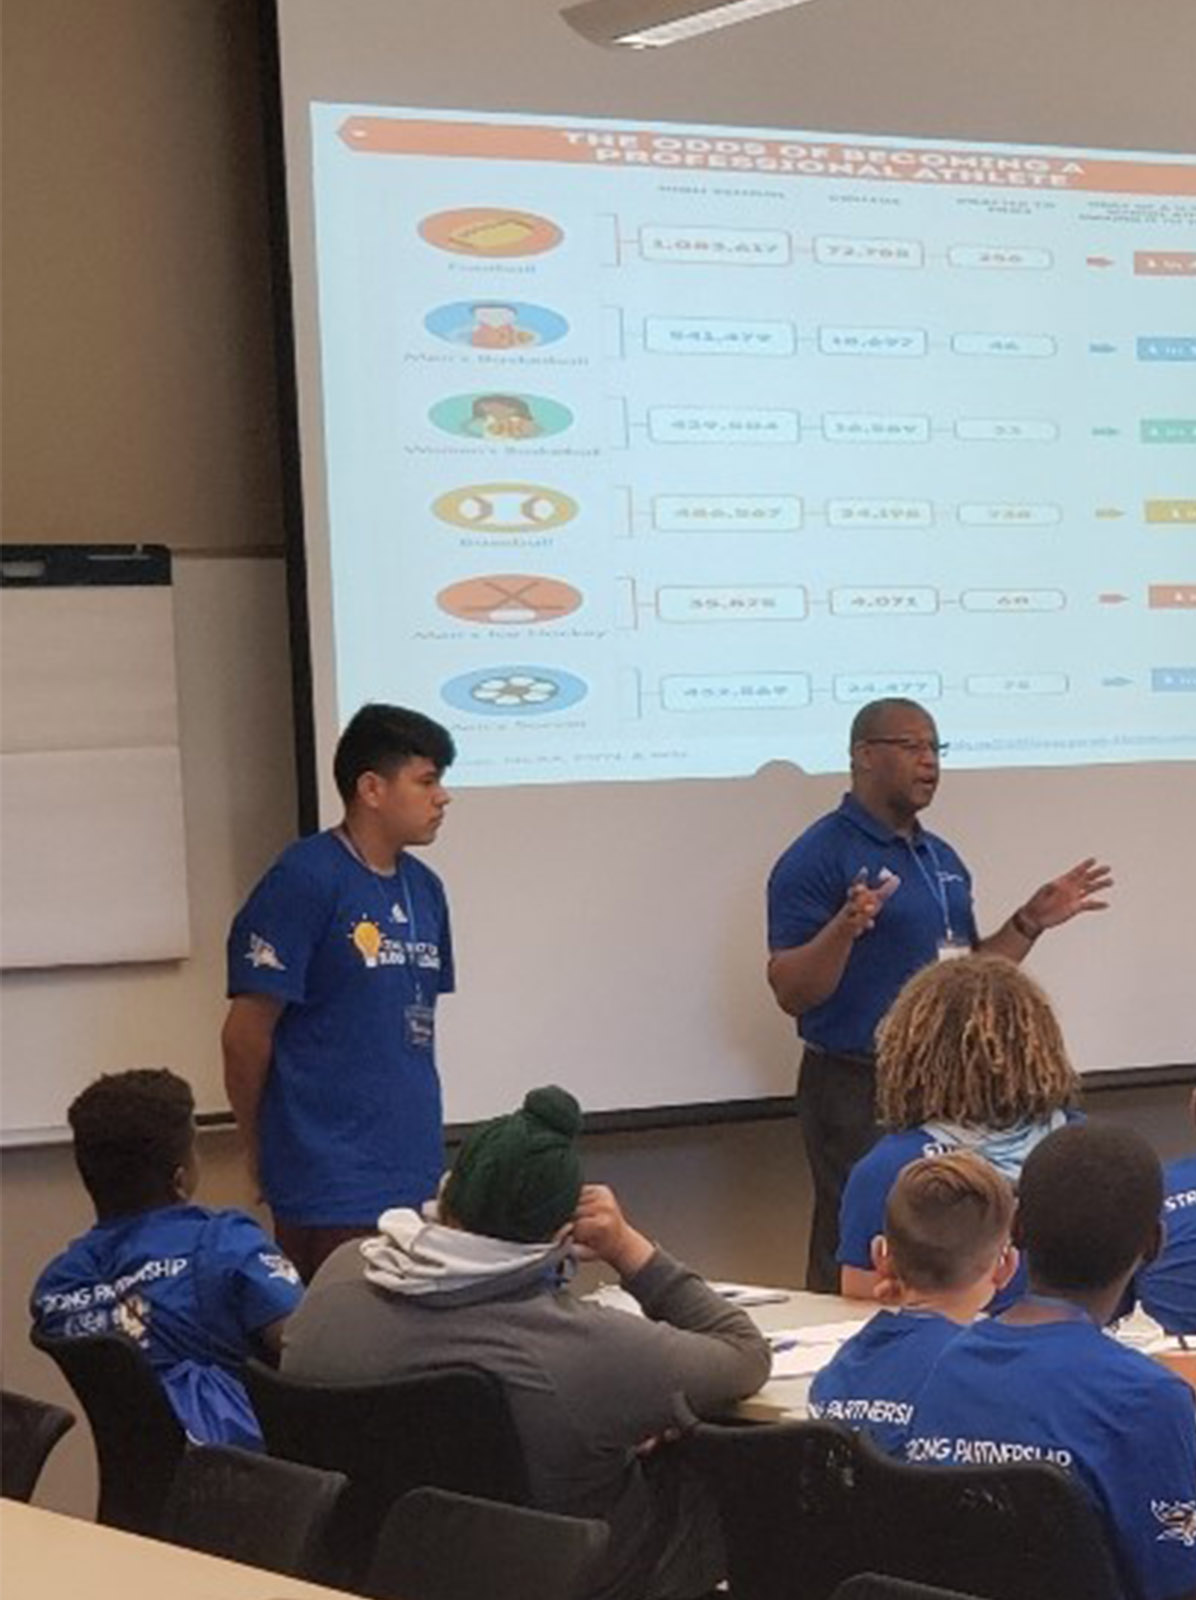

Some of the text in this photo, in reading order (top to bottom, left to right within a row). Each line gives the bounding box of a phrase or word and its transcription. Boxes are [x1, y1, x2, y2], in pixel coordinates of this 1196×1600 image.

[566, 131, 1086, 175] THE ODDS OF BECOMING A
[595, 147, 1072, 187] PROFESSIONAL ATHLETE
